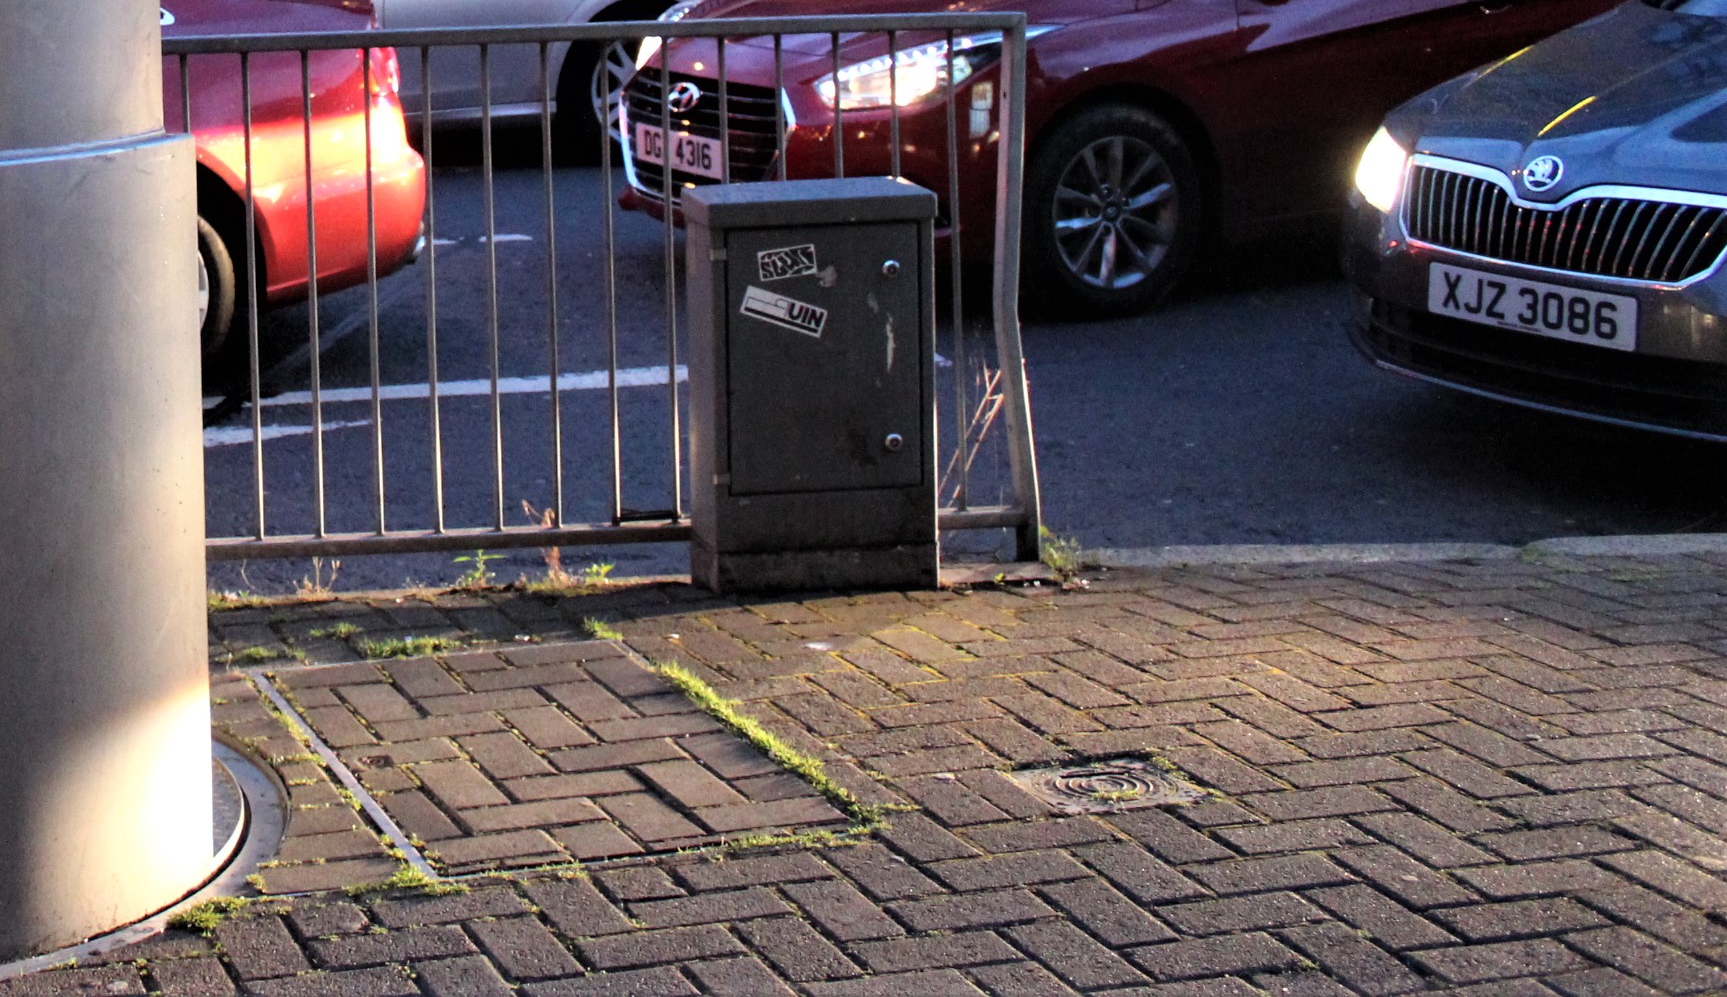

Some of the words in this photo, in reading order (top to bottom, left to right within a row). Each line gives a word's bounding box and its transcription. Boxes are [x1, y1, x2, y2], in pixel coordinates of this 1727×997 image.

[644, 129, 662, 158] DG
[676, 138, 712, 170] 4316
[1443, 272, 1505, 319] XJZ
[1518, 288, 1618, 340] 3086
